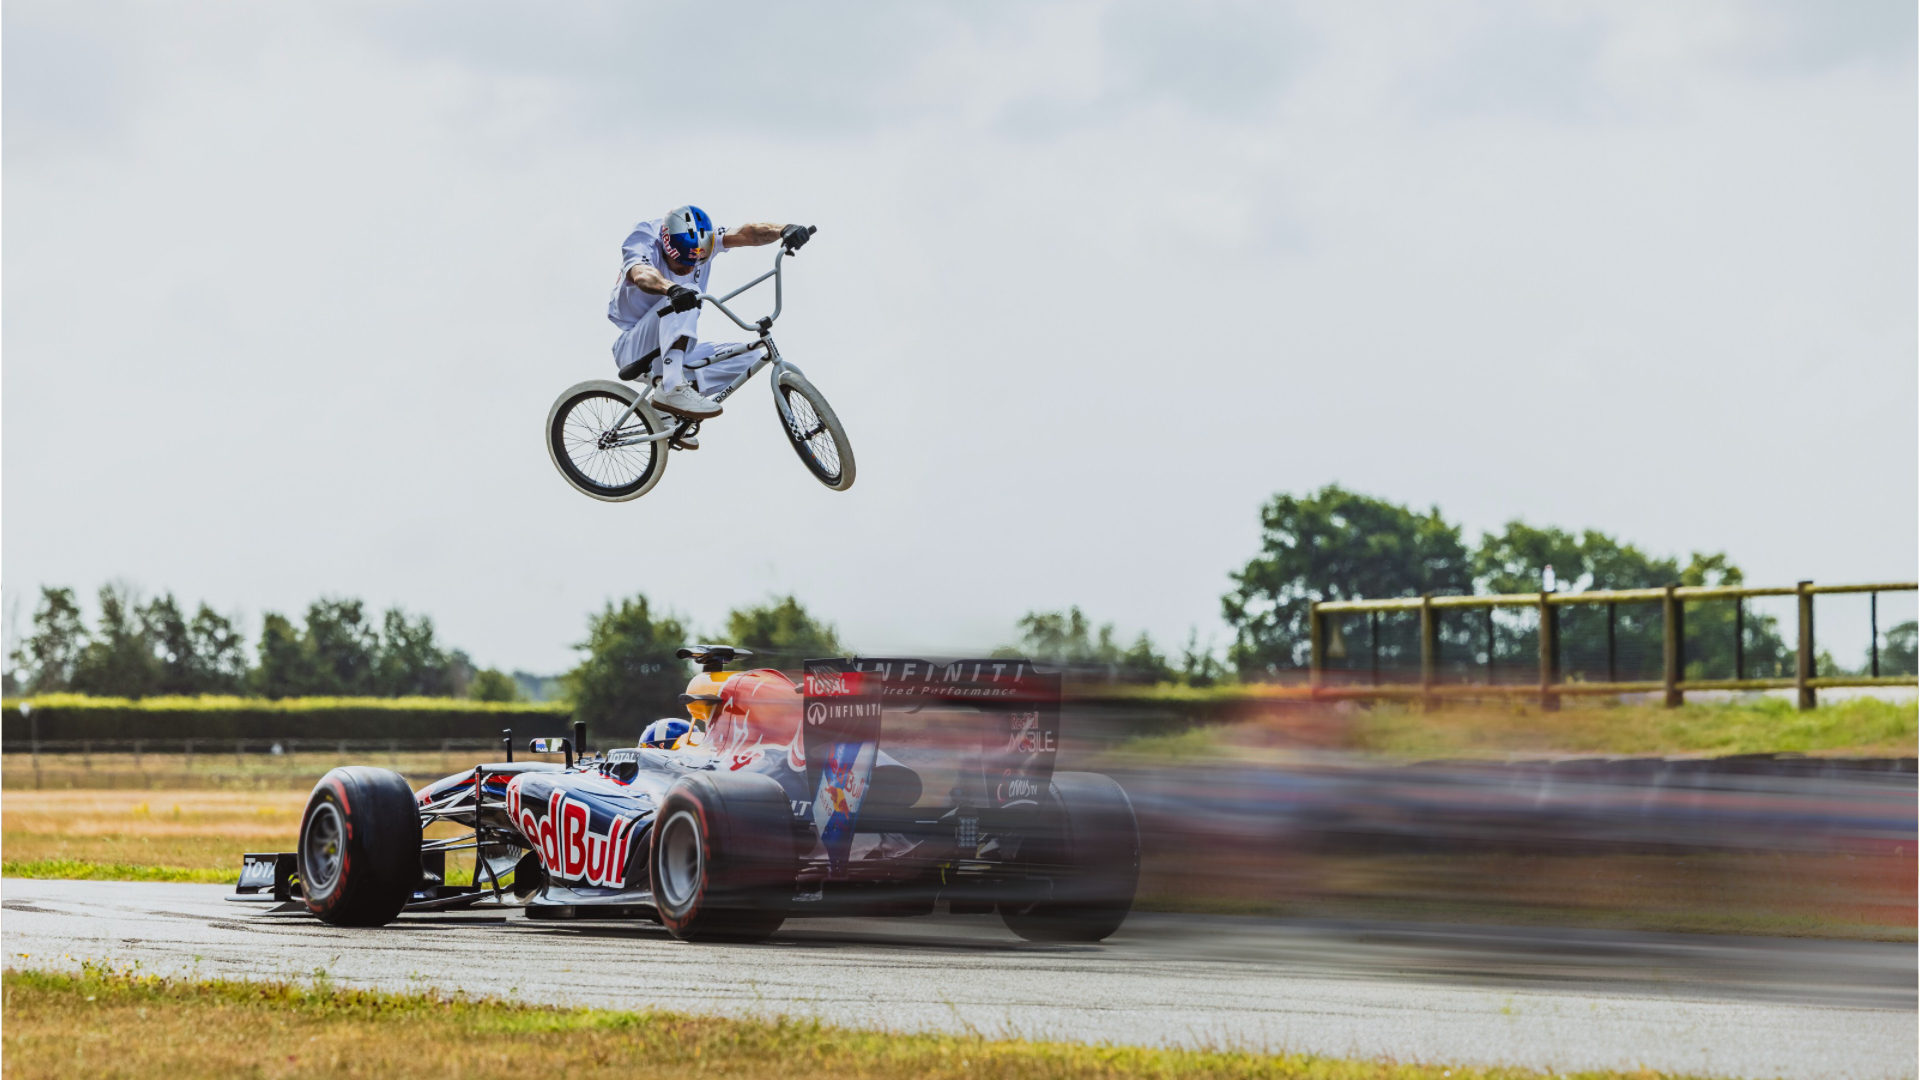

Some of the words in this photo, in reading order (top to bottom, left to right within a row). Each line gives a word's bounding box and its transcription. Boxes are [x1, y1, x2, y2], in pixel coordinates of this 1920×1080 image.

[712, 386, 734, 404] DOM
[829, 703, 881, 718] INFINITI
[561, 797, 636, 888] Bull
[245, 857, 275, 878] TOTA
